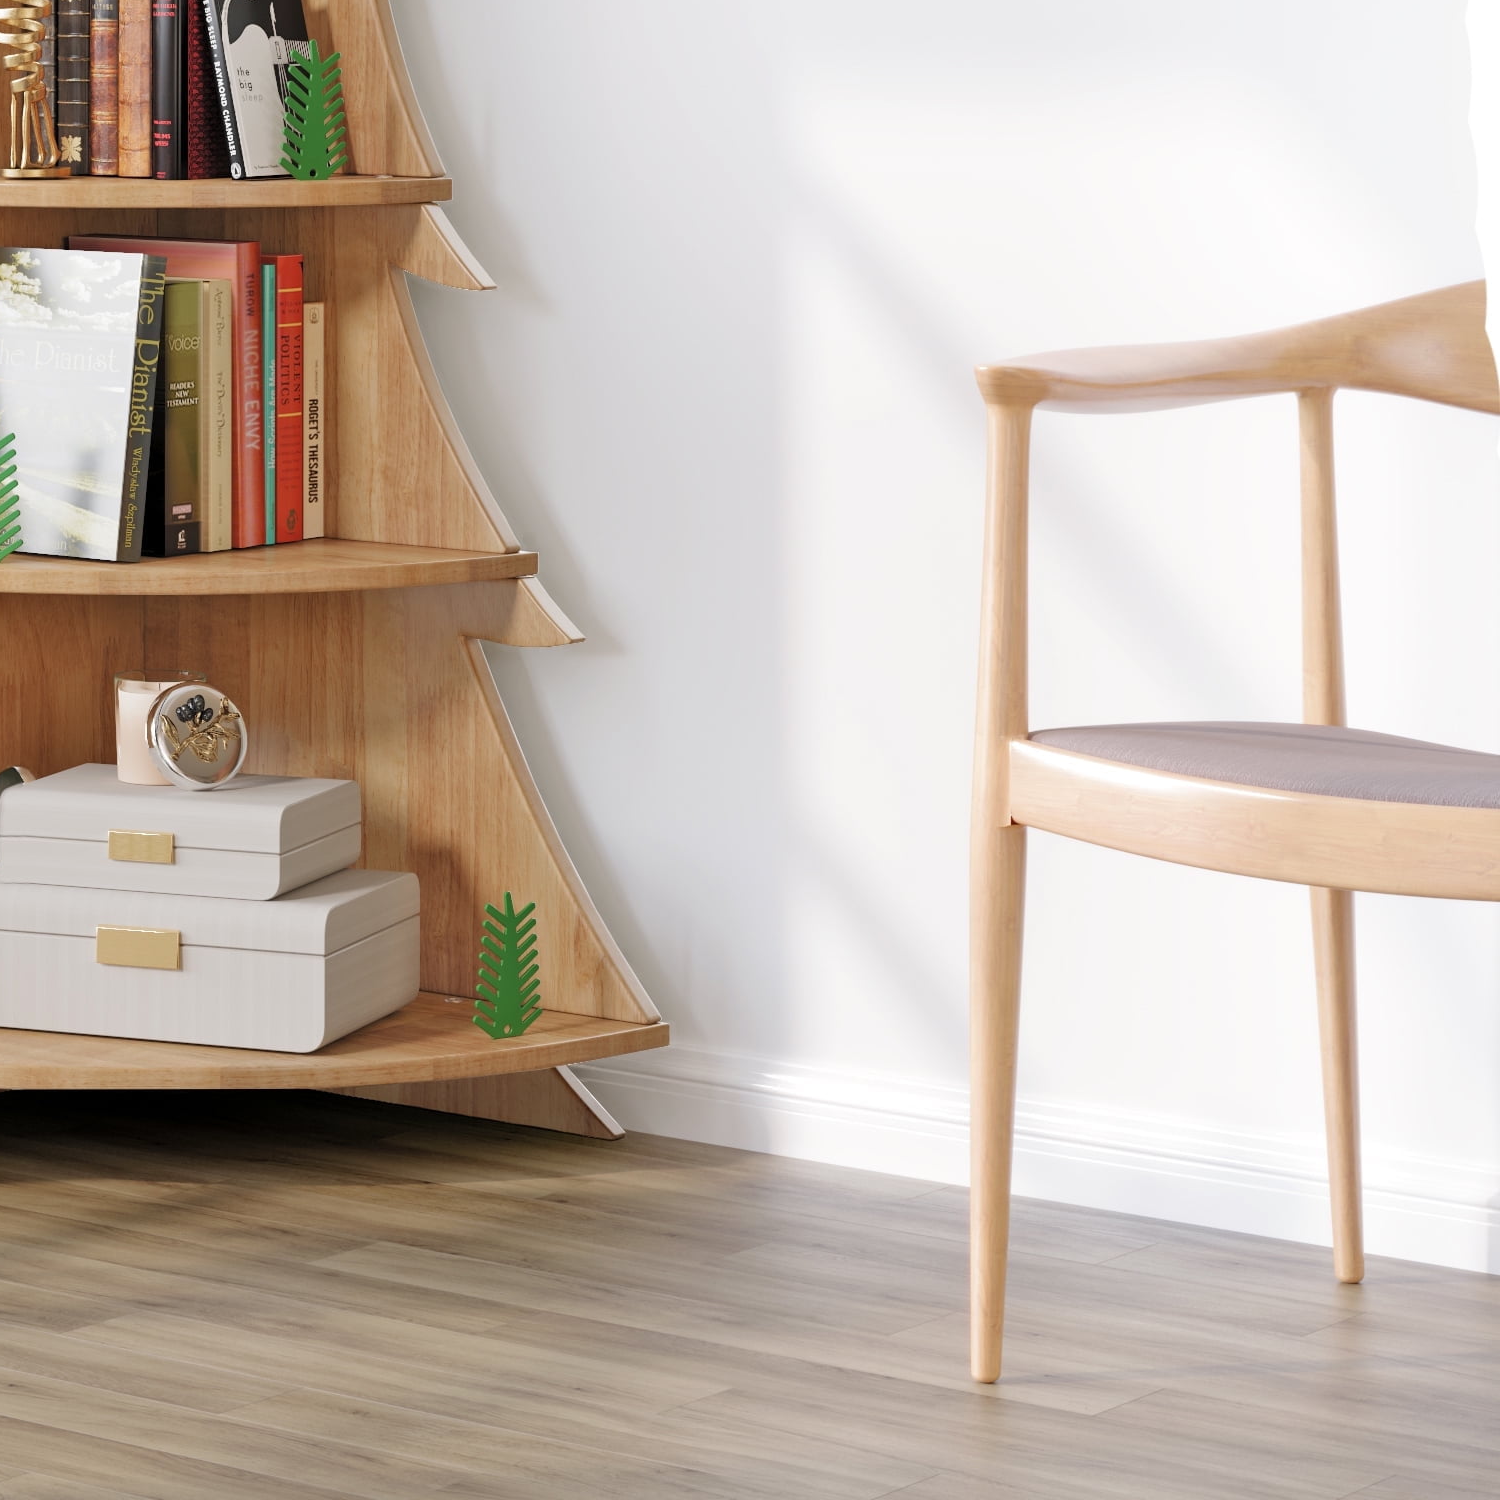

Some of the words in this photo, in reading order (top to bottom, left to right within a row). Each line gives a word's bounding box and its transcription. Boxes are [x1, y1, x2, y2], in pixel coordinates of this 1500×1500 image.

[204, 7, 213, 23] BIG
[207, 25, 218, 50] SLEEP
[214, 61, 228, 107] RAYMOND
[236, 67, 250, 76] the
[239, 79, 253, 91] big
[222, 109, 237, 157] CHANDLER
[138, 272, 166, 325] The
[246, 273, 255, 316] TUROW
[35, 340, 121, 373] Pianist
[243, 329, 259, 393] NICHE
[280, 335, 290, 405] POLITICS
[293, 333, 301, 403] VIOLENT
[129, 338, 161, 438] Pianist
[167, 397, 199, 408] TESTAMENT
[175, 390, 189, 398] NEW
[244, 400, 260, 450] ENVY
[308, 399, 320, 440] ROGET'S
[267, 447, 275, 469] How
[308, 445, 319, 503] THESAURUS
